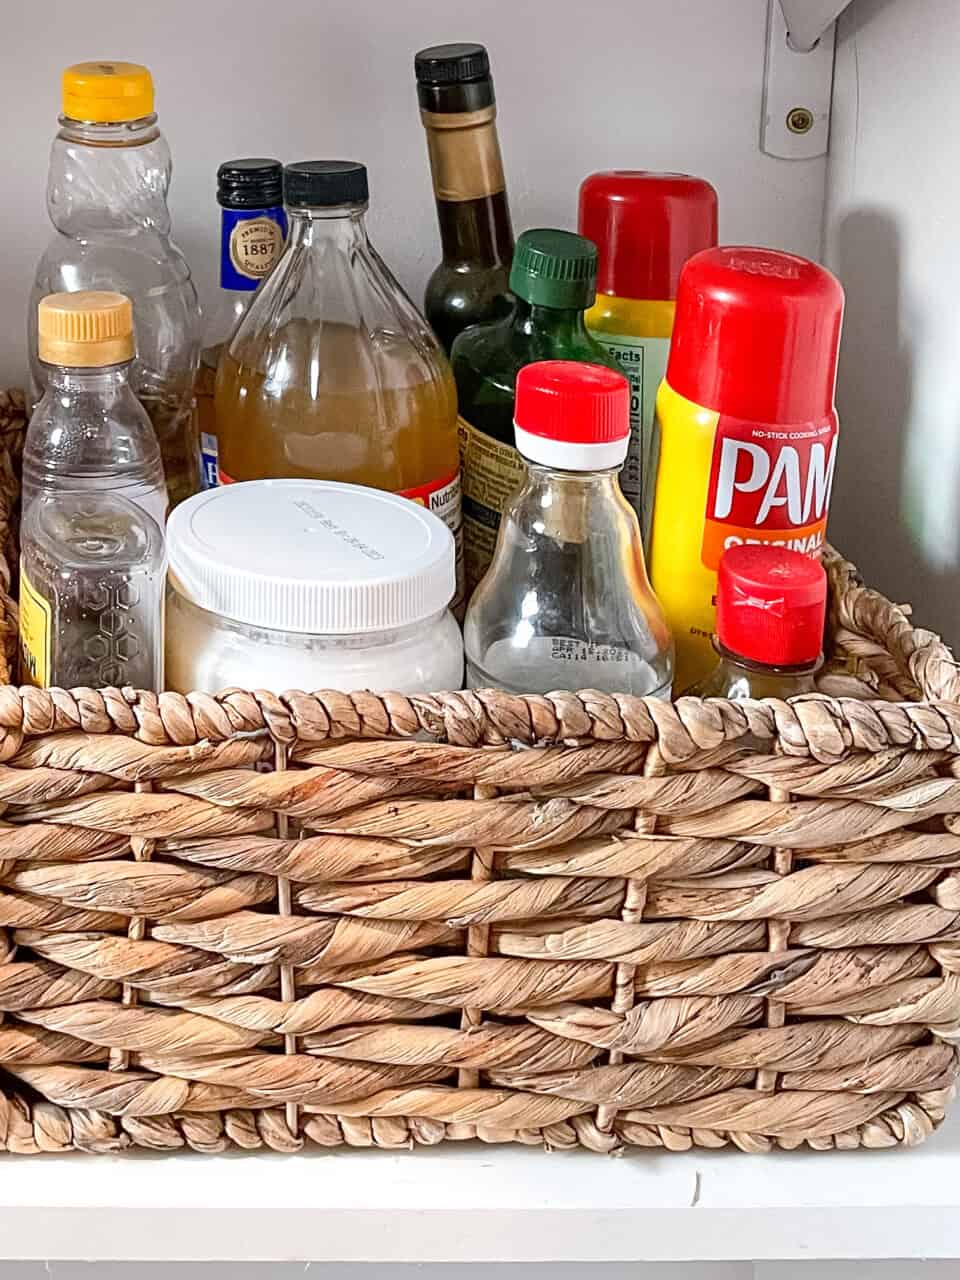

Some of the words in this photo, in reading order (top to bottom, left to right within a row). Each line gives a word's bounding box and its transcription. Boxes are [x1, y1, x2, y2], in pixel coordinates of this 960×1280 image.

[243, 243, 275, 256] 1887
[751, 429, 788, 440] NO-STICK
[714, 433, 838, 525] PAM
[724, 530, 823, 555] OINAL
